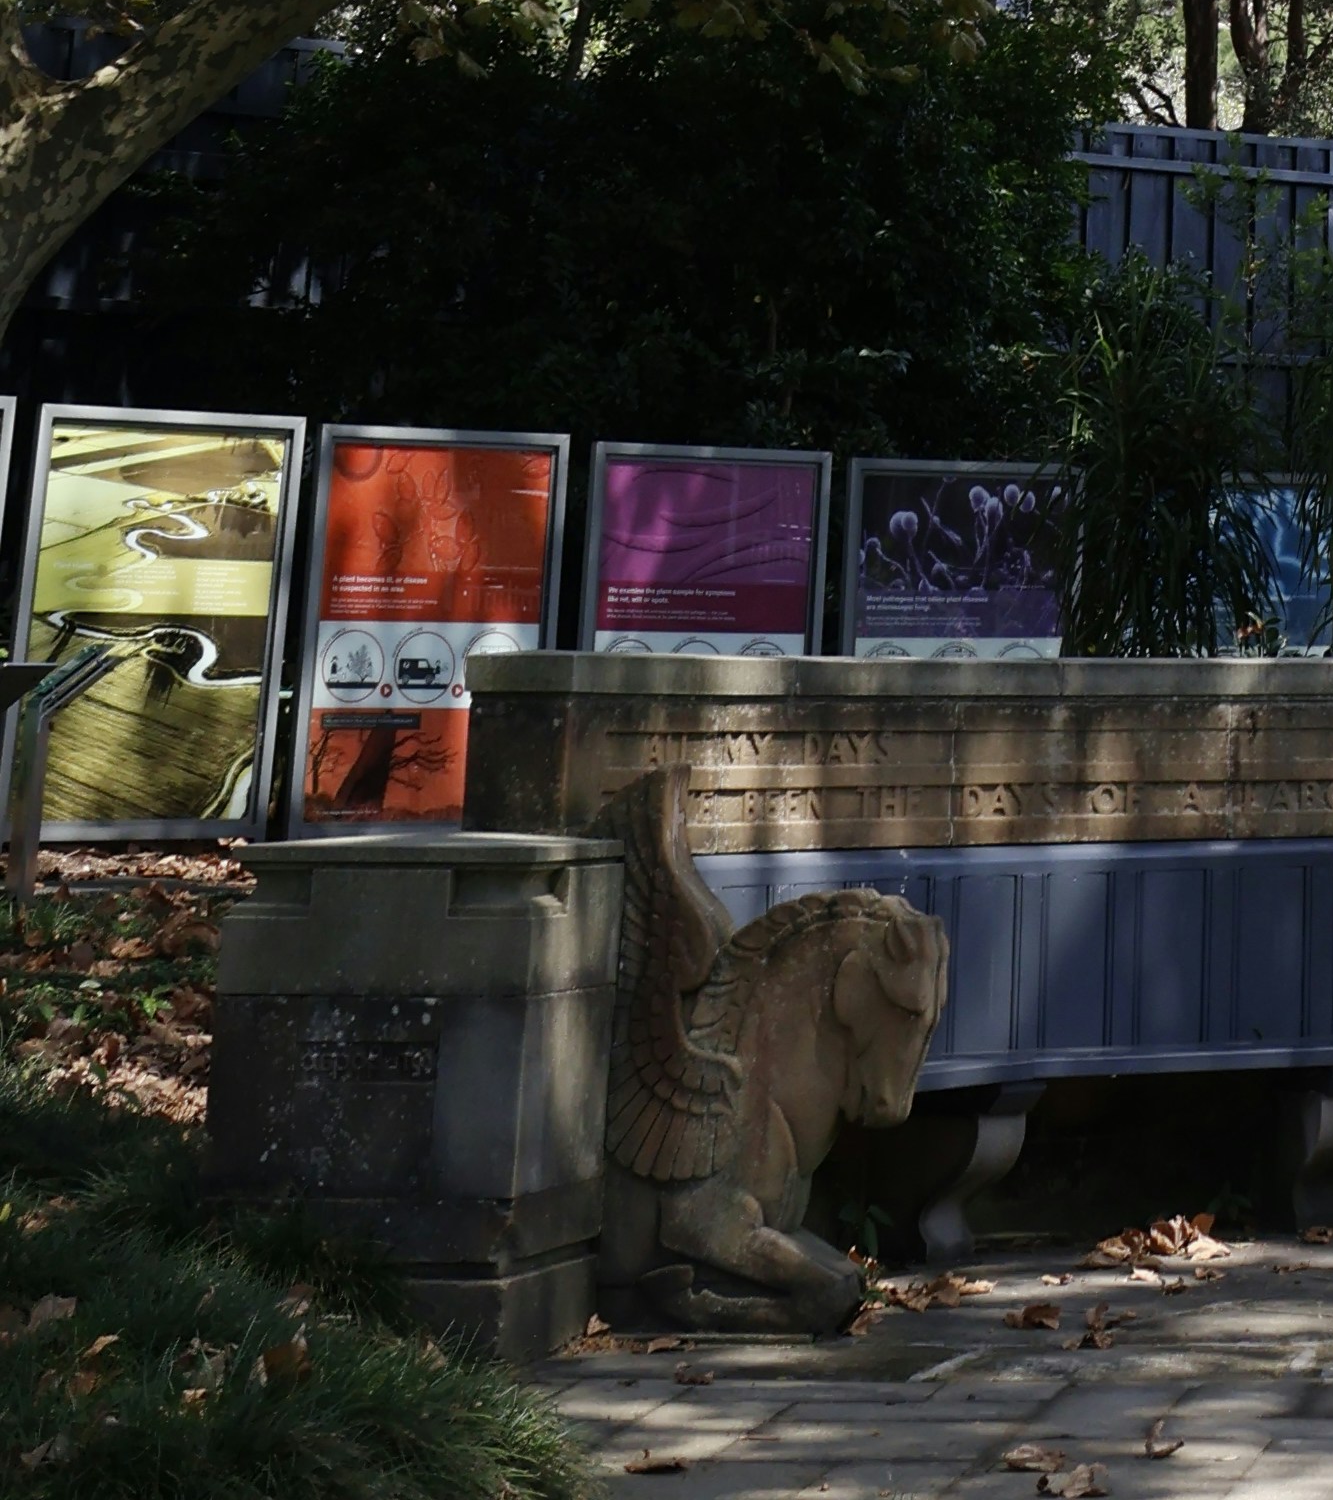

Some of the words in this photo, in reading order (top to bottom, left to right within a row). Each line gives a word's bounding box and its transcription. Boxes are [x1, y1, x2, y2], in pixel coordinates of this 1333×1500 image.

[608, 586, 619, 594] We
[619, 587, 645, 595] examine
[673, 589, 695, 597] sample
[724, 732, 775, 764] MY
[803, 732, 890, 763] DAYS
[743, 789, 827, 822] BEEN
[857, 785, 926, 819] THE
[960, 782, 1062, 818] DAYS
[1090, 781, 1143, 814] OF
[1184, 783, 1205, 812] A
